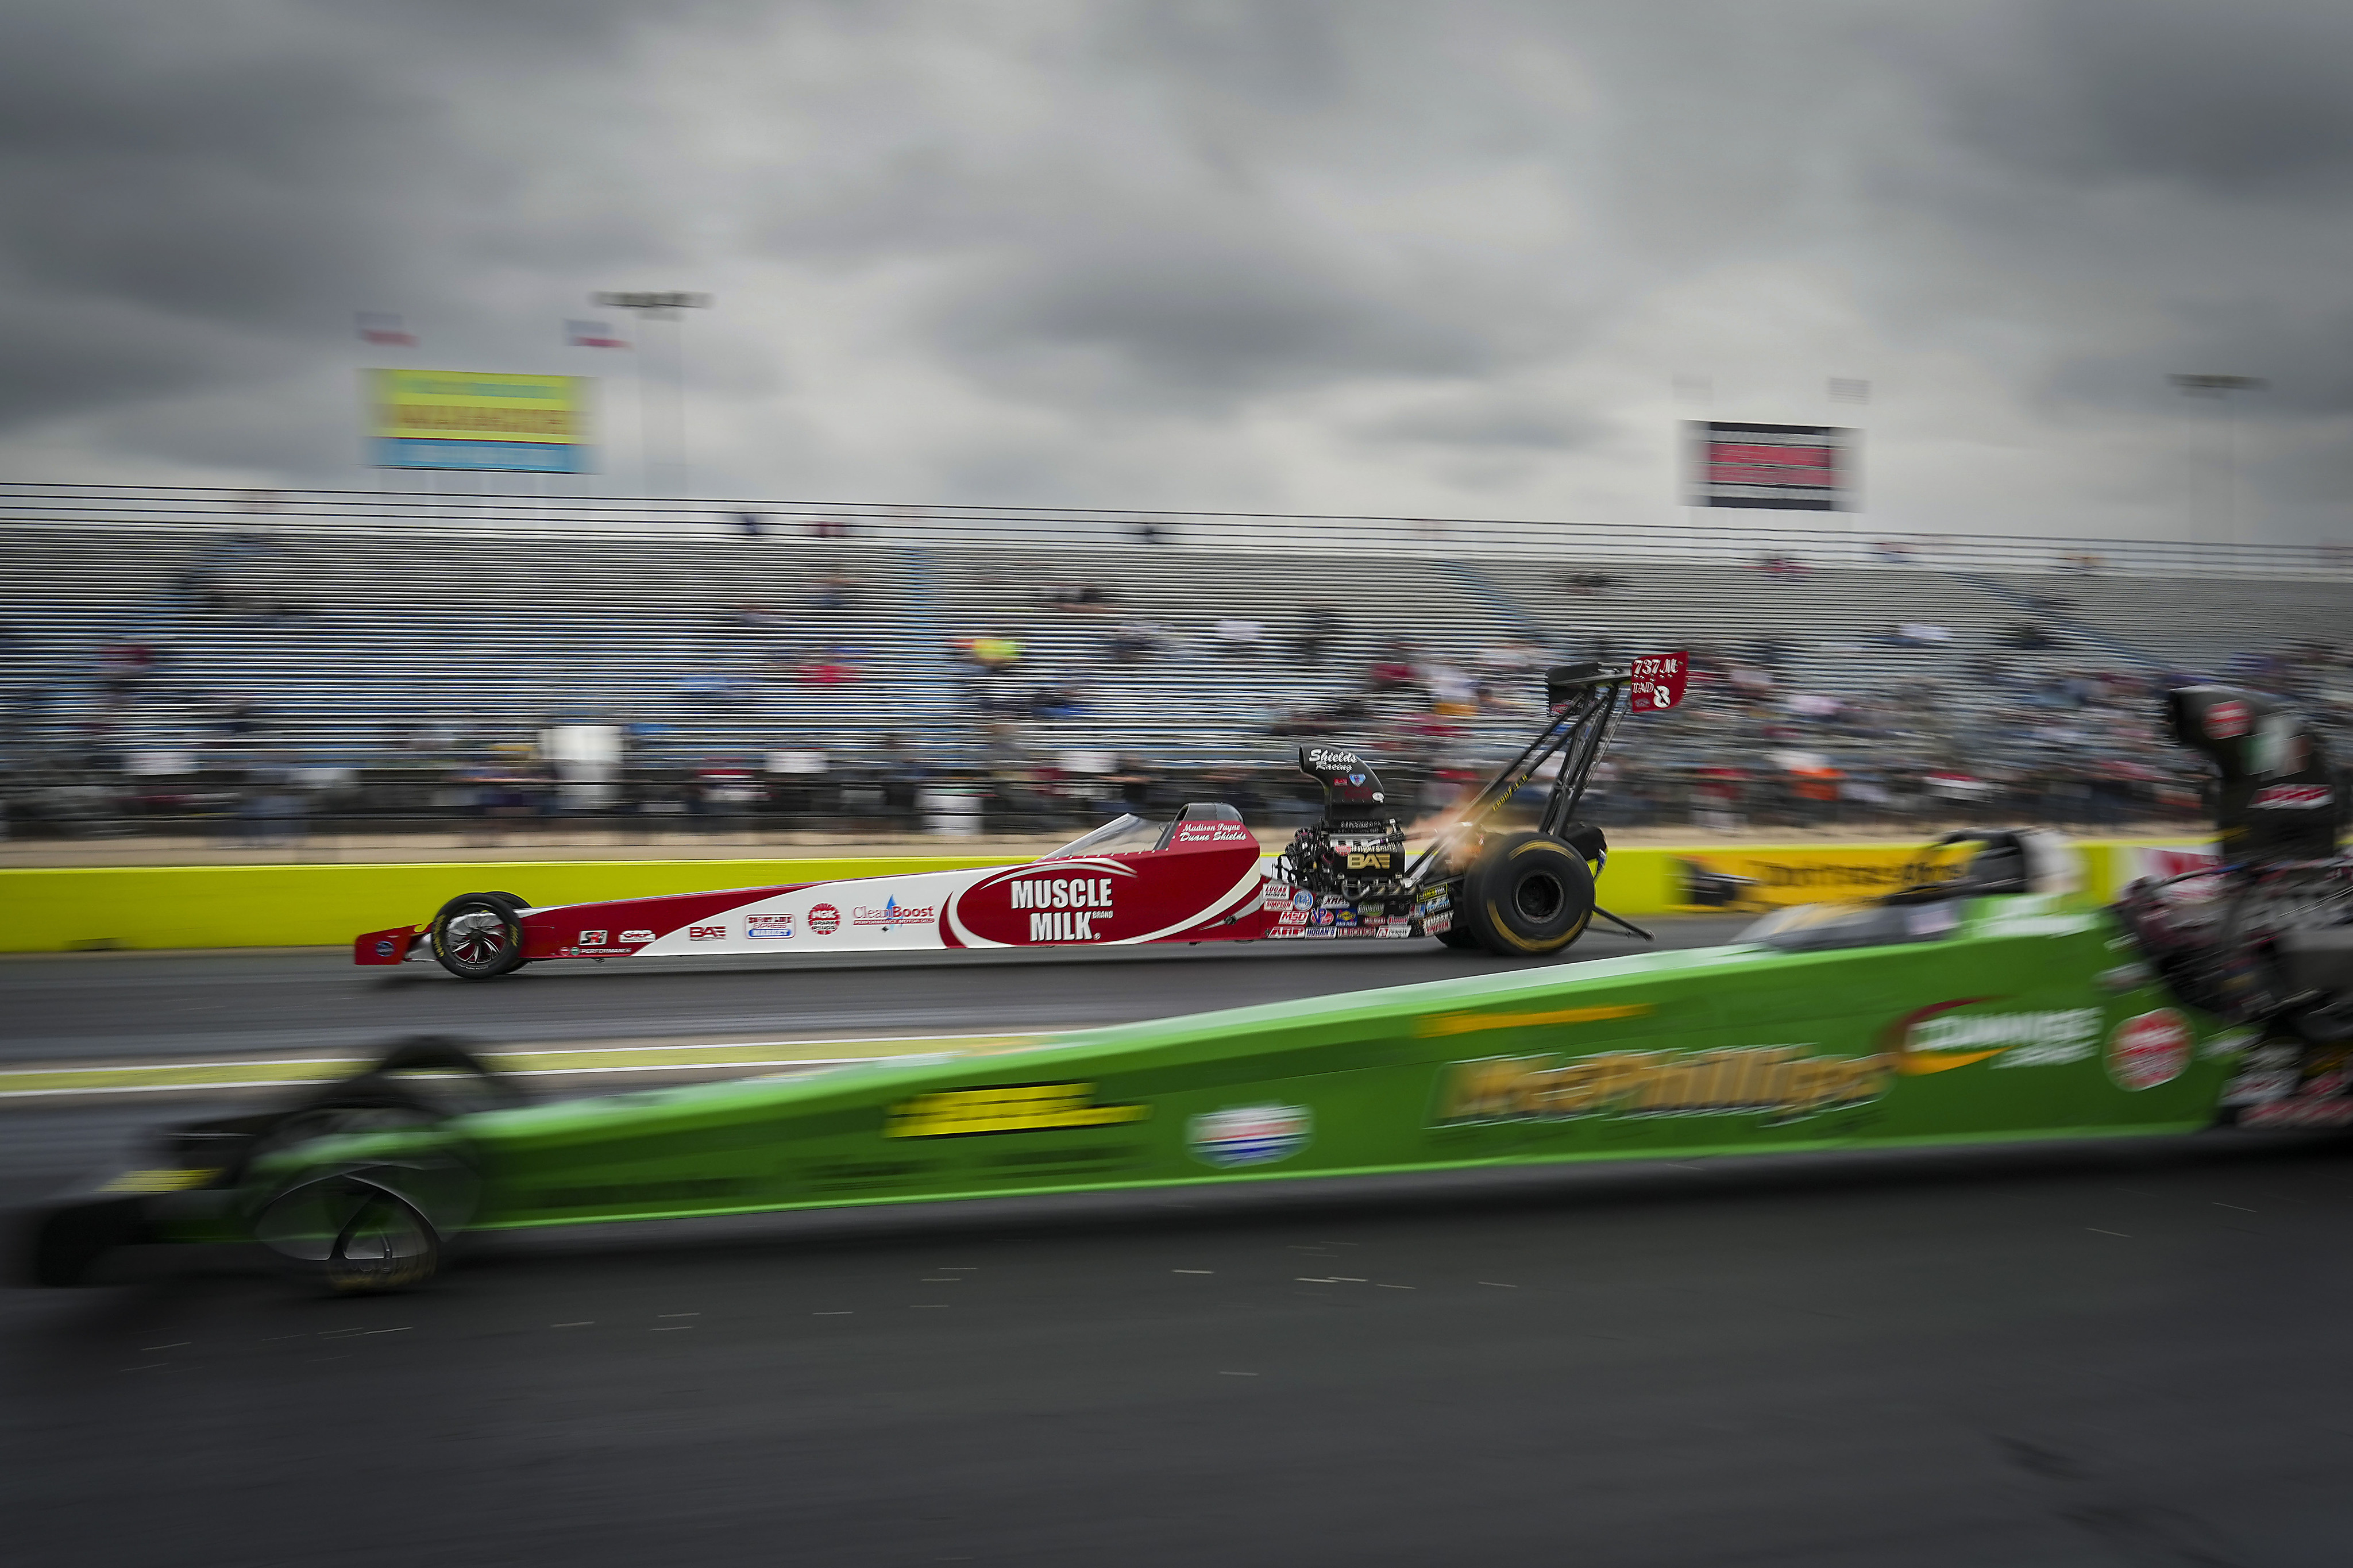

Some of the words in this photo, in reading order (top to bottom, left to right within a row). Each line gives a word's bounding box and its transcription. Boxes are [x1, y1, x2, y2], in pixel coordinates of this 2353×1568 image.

[1634, 659, 1661, 674] 737
[1631, 682, 1654, 694] TAD
[1653, 685, 1671, 708] 8
[1309, 749, 1358, 763] Shields
[1316, 760, 1353, 773] Racing
[1182, 823, 1216, 832] Madison
[1217, 822, 1241, 833] Payne
[1179, 832, 1210, 842] Duane
[1212, 831, 1247, 841] Shields
[1347, 853, 1390, 870] BAE
[1010, 878, 1113, 909] MUSCLE
[812, 910, 836, 918] NGK
[854, 905, 935, 919] CleanBoost
[689, 926, 726, 937] BAE
[1029, 911, 1093, 941] MILK
[1091, 910, 1113, 919] BRAND
